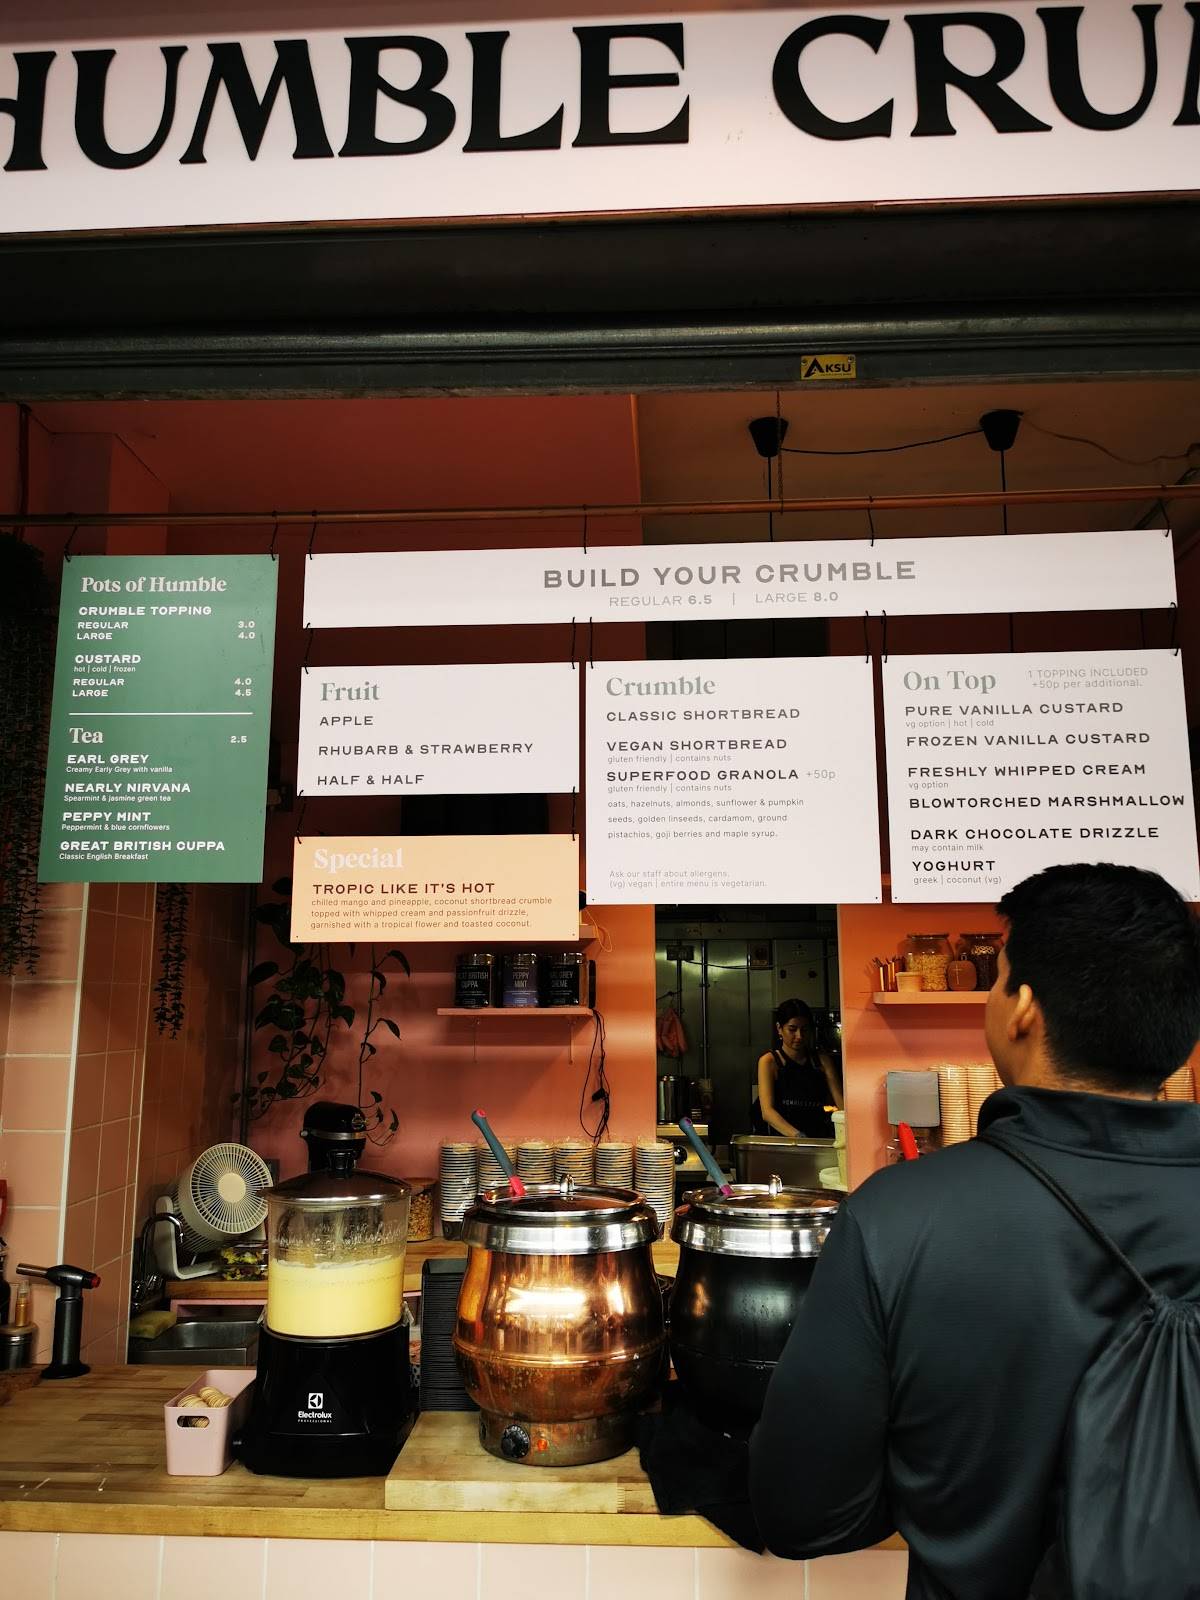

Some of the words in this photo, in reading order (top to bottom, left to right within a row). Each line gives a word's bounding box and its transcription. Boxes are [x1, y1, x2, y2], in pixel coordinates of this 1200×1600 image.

[804, 357, 852, 378] AKSU
[544, 568, 639, 588] BUILD
[652, 566, 740, 585] YOUR
[755, 561, 915, 583] CRUMBLE
[81, 577, 120, 592] Pots
[125, 577, 146, 592] of
[149, 576, 226, 592] Humble
[609, 595, 682, 607] REGULAR
[687, 594, 712, 605] 6.5
[755, 592, 807, 603] LARGE
[813, 591, 838, 602] 8.0
[78, 606, 145, 615] CRUMBLE
[150, 606, 211, 615] TOPPING
[238, 620, 255, 628] 3.0
[76, 632, 112, 640] LARGE
[75, 654, 141, 663] CUSTARD
[1036, 669, 1086, 679] TOPPING
[1090, 667, 1148, 677] INCLUDED
[73, 678, 124, 686] REGULAR
[234, 677, 251, 685] 4.0
[606, 676, 715, 696] Crumble
[903, 671, 940, 690] On
[946, 670, 996, 694] Top
[234, 688, 251, 696] 4.5
[320, 681, 379, 701] Fruit
[606, 711, 676, 721] CLASSIC
[683, 708, 799, 720] SHORTBREAD
[905, 706, 952, 716] PURE
[959, 704, 1032, 715] VANILLA
[1039, 702, 1122, 714] CUSTARD
[319, 716, 373, 726] APPLE
[69, 727, 103, 743] Tea
[906, 736, 976, 746] FROZEN
[984, 734, 1058, 745] VANILLA
[1065, 733, 1149, 744] CUSTARD
[318, 745, 398, 755] RHUBARB
[404, 744, 413, 754] &
[420, 743, 532, 754] STRAWBERRY
[606, 741, 662, 751] VEGAN
[670, 739, 786, 750] SHORTBREAD
[67, 754, 105, 763] EARL
[110, 754, 148, 763] GREY
[607, 755, 633, 765] gluten
[636, 755, 666, 763] friendly
[676, 753, 712, 762] contains
[714, 753, 731, 761] nuts
[65, 766, 93, 774] Creamy
[94, 766, 112, 774] Early
[114, 766, 131, 774] Grey
[606, 770, 710, 781] SUPERFOOD
[717, 769, 798, 780] GRANOLA
[805, 769, 836, 780] +50p
[908, 766, 987, 777] FRESHLY
[994, 765, 1075, 776] WHIPPED
[1082, 764, 1144, 775] CREAM
[317, 775, 360, 785] HALF
[366, 775, 374, 784] &
[382, 774, 424, 784] HALF
[65, 783, 122, 792] NEARLY
[126, 783, 190, 792] NIRVANA
[108, 794, 135, 802] jasmine
[768, 798, 803, 807] pumpkin
[909, 797, 1040, 808] BLOWTORCHED
[1048, 795, 1184, 806] MARSHMALLOW
[62, 812, 112, 821] PEPPY
[116, 812, 151, 821] MINT
[637, 816, 665, 824] golden
[757, 814, 787, 823] ground
[655, 831, 670, 839] goji
[723, 830, 748, 838] maple
[911, 829, 957, 840] DARK
[965, 828, 1072, 839] CHOCOLATE
[1080, 827, 1158, 838] DRIZZLE
[60, 841, 109, 850] GREAT
[113, 841, 171, 850] BRITISH
[176, 841, 224, 850] CUPPA
[911, 844, 929, 854] may
[931, 842, 963, 851] contain
[965, 842, 983, 851] milk
[86, 852, 113, 861] English
[312, 848, 403, 874] Special
[912, 860, 995, 871] YOGHURT
[913, 876, 938, 885] greek
[946, 874, 982, 884] coconut
[984, 875, 1001, 884] (vg)
[312, 884, 374, 894] TROPIC
[381, 883, 417, 894] LIKE
[425, 883, 455, 893] IT'S
[462, 883, 494, 893] HOT
[311, 897, 338, 906] chilled
[370, 897, 386, 905] and
[470, 897, 516, 905] shortbread
[518, 896, 552, 904] crumble
[311, 910, 339, 918] topped
[362, 909, 397, 919] whipped
[428, 908, 443, 916] and
[446, 908, 495, 919] passionfruit
[310, 920, 351, 930] garnished
[353, 920, 371, 928] with
[381, 920, 412, 928] tropical
[415, 920, 441, 928] flower
[443, 919, 458, 927] and
[460, 919, 494, 927] toasted
